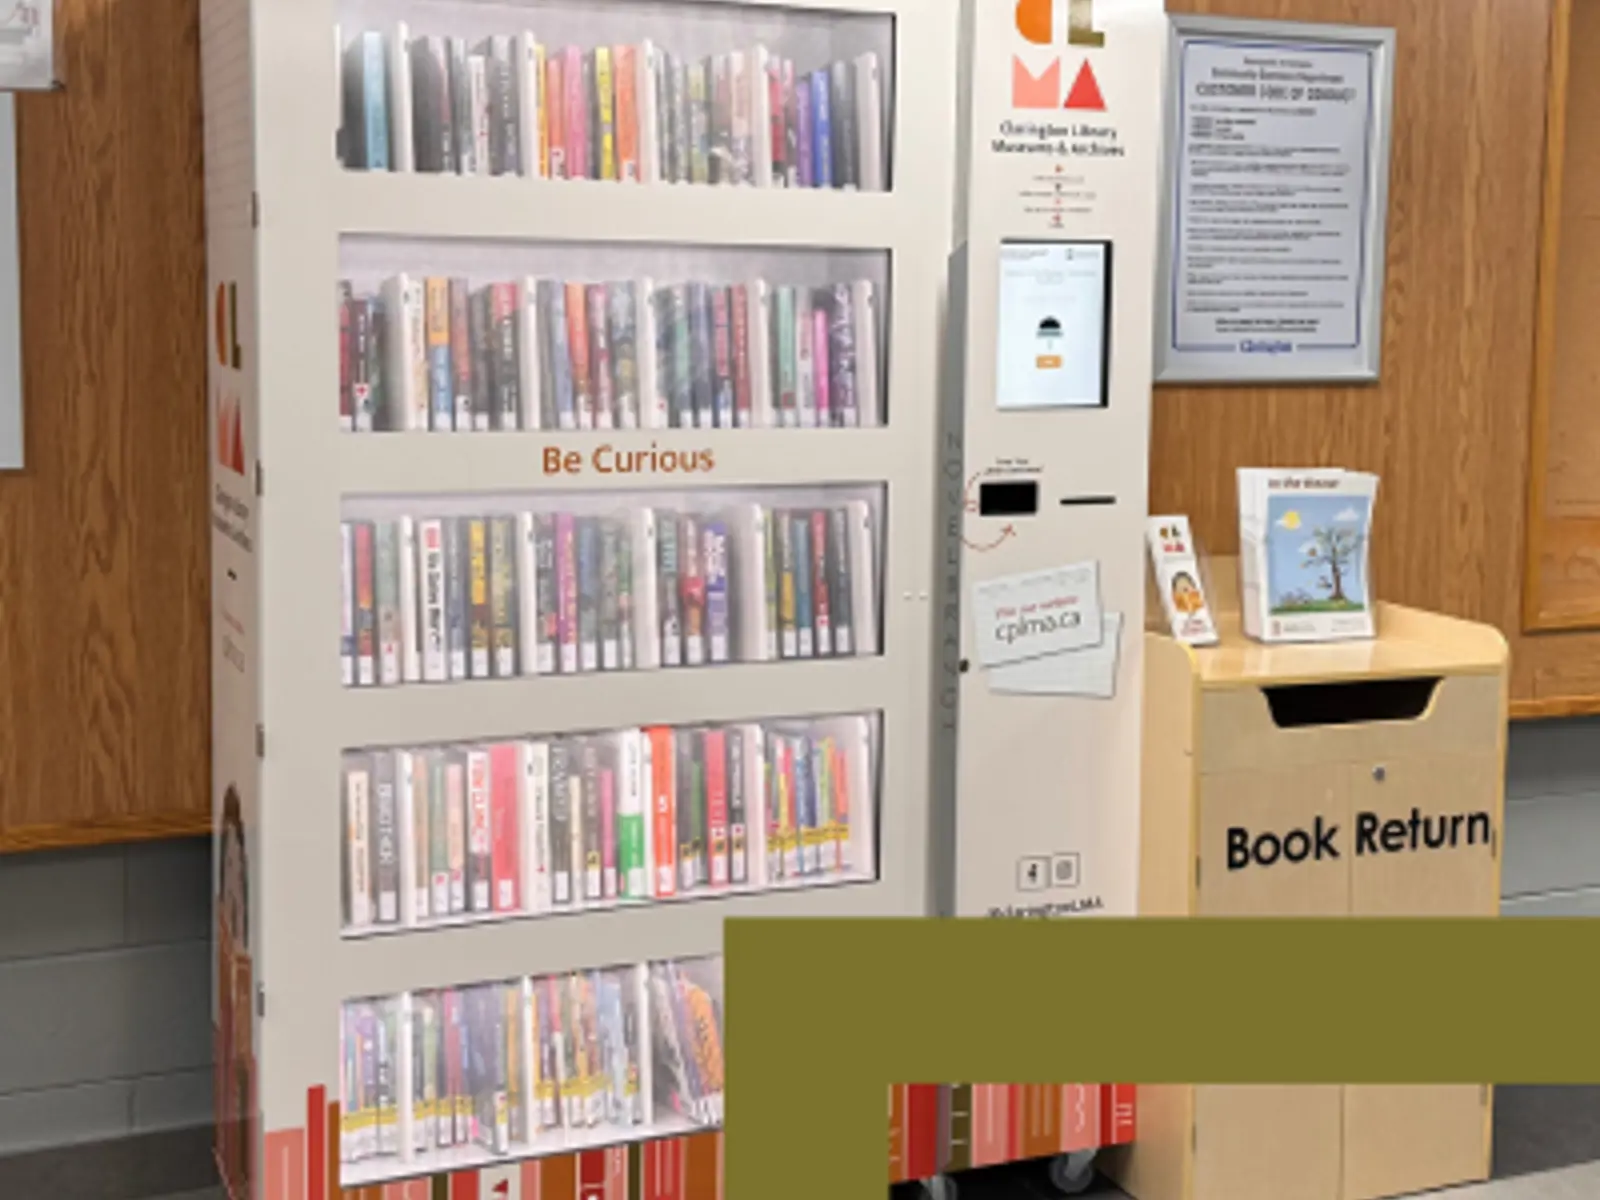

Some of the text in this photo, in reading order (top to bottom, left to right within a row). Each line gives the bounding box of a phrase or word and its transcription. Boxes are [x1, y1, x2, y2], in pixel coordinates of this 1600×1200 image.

[542, 440, 715, 476] Be Curious
[1227, 807, 1490, 871] Book Return
